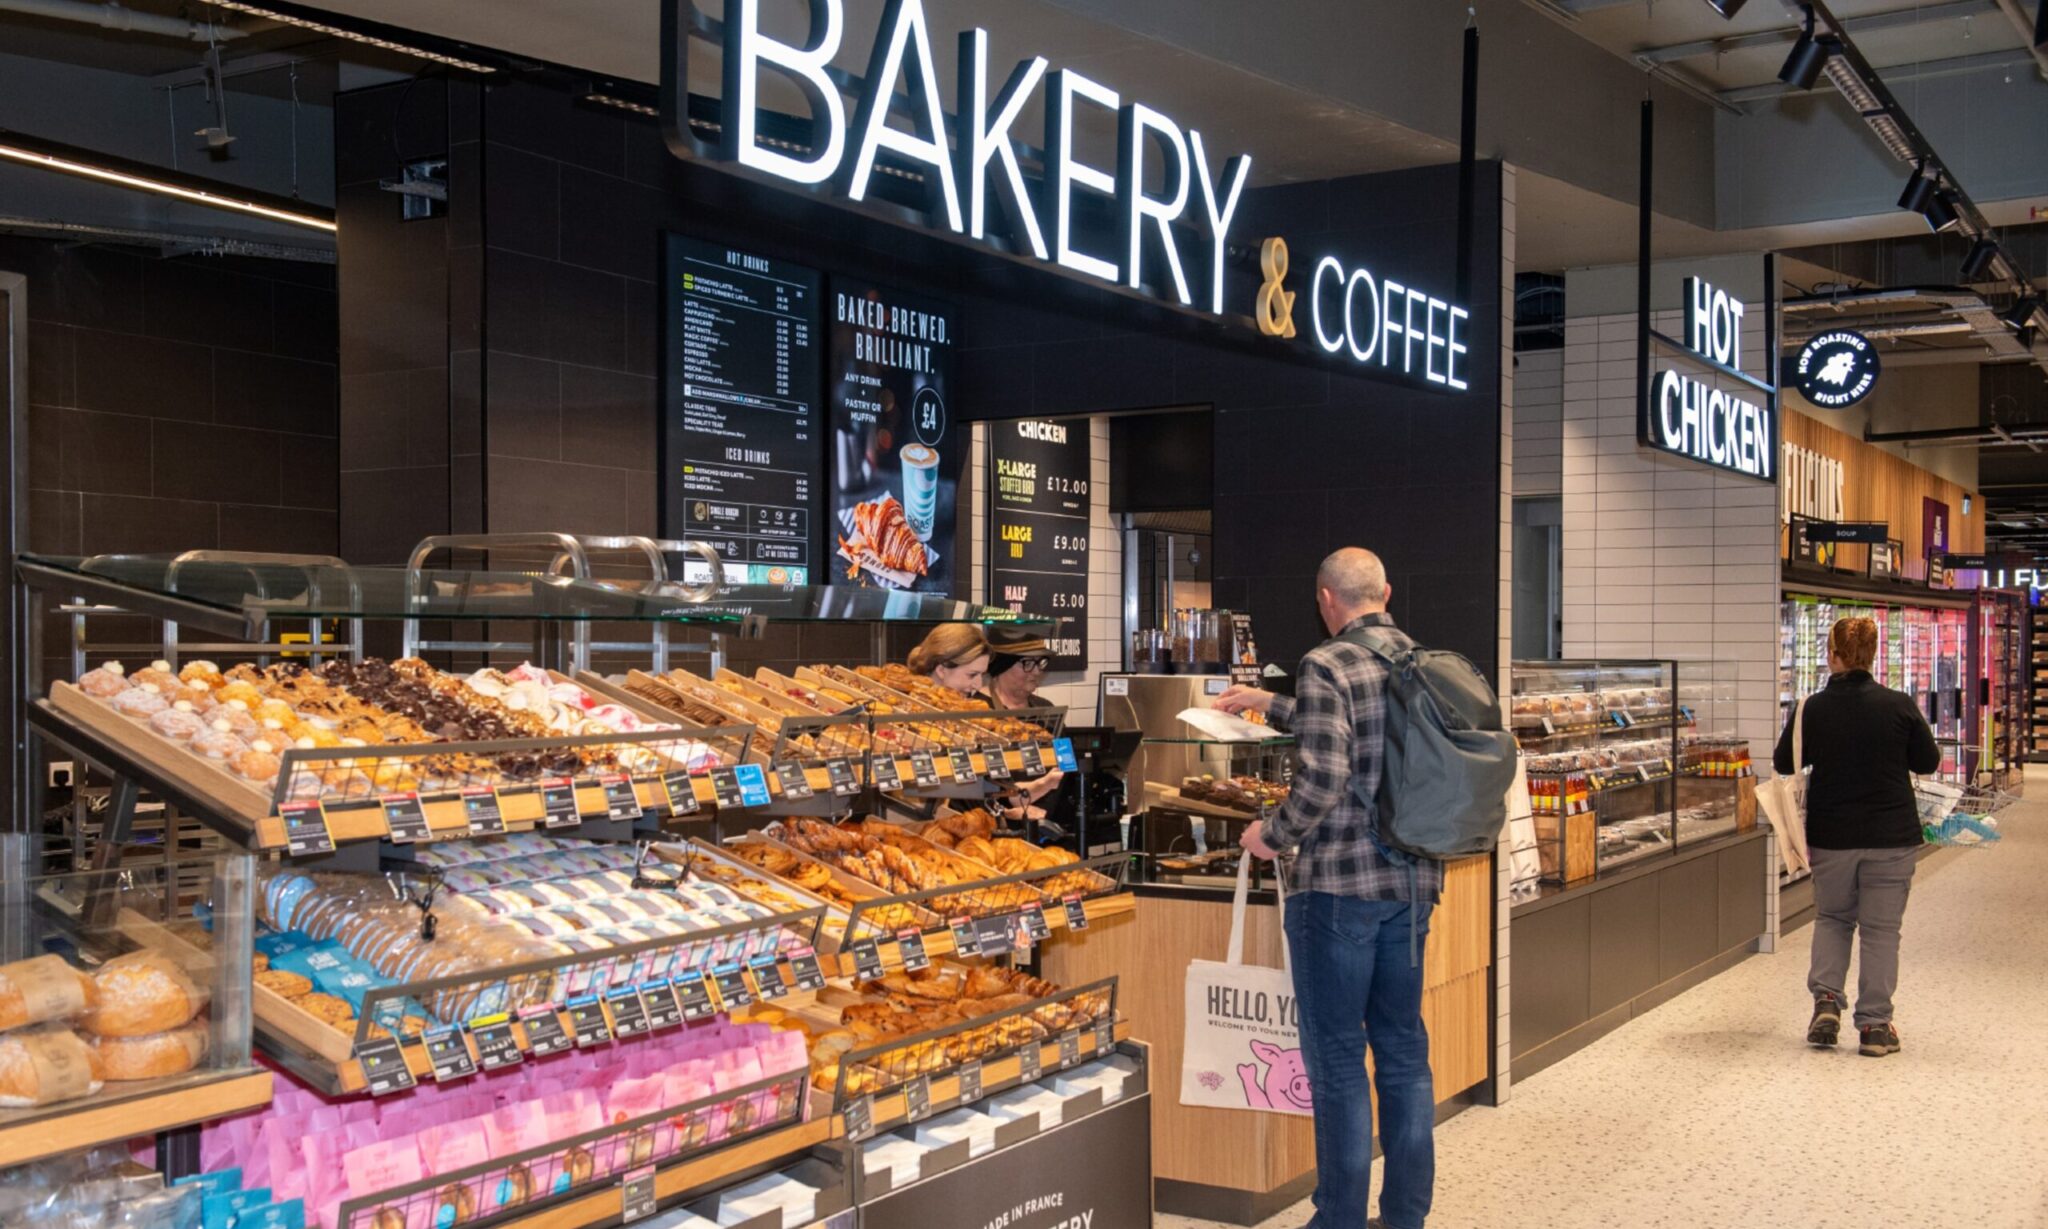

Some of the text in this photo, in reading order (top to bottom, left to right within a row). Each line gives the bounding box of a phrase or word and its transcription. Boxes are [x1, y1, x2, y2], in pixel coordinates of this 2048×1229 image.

[738, 0, 1468, 391] BAKERY & COFFEE
[726, 250, 768, 272] HOT DRINKS
[1693, 276, 1743, 371] HOT
[856, 332, 935, 374] BRILLIANT.
[1798, 333, 1866, 374] NOW ROASTING
[844, 372, 882, 387] ANY DRINK
[1814, 373, 1873, 404] RIGHT HERE
[845, 398, 881, 412] PASTRY OR
[850, 412, 876, 423] MUFFIN
[922, 402, 936, 430] £4
[1661, 370, 1769, 477] CHICKEN
[1018, 421, 1066, 444] CHICKEN
[726, 447, 770, 464] ICED DRINKS
[997, 458, 1036, 479] X-LARGE
[1047, 477, 1087, 495] £12.00
[1002, 525, 1032, 542] LARGE
[1054, 536, 1086, 551] £9.00
[1005, 586, 1028, 601] HALF
[1053, 593, 1085, 608] £5.00
[1208, 985, 1299, 1027] HELLO, YO
[1208, 1019, 1244, 1031] WELCOME
[1247, 1025, 1257, 1033] TO
[1260, 1027, 1279, 1036] YOUR
[1011, 1204, 1023, 1221] IN
[1025, 1192, 1063, 1215] FRANCE
